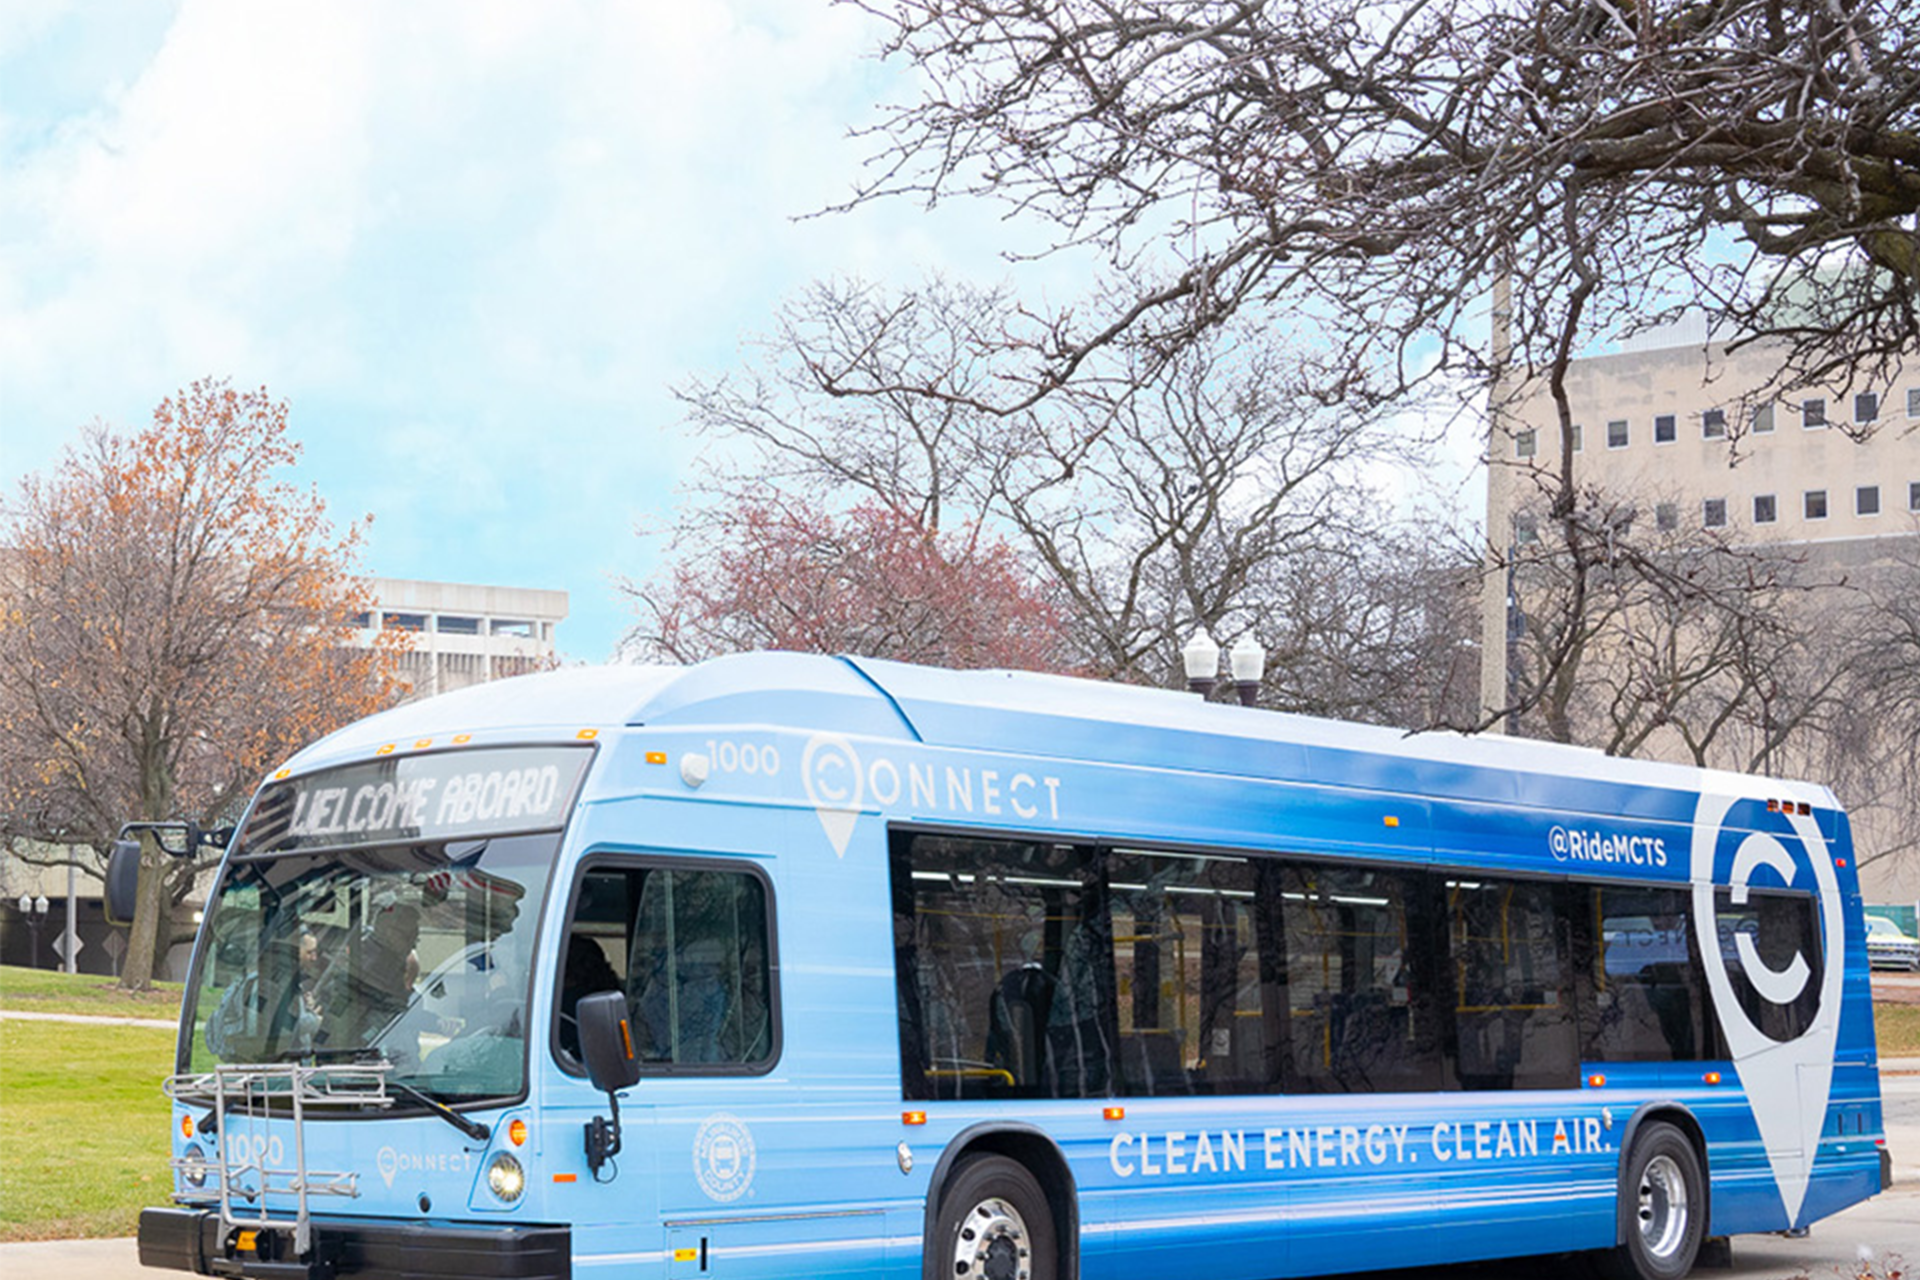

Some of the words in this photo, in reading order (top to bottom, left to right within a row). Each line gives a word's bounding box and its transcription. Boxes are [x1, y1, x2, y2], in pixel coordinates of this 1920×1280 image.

[706, 740, 780, 776] 1000
[804, 738, 1060, 820] CONNECT
[289, 780, 434, 836] WELCOME
[438, 766, 559, 825] ABOARD
[1549, 825, 1668, 867] @RideMCTS
[226, 1134, 284, 1166] 1000
[378, 1148, 471, 1173] CONNECT
[1109, 1130, 1246, 1177] CLEAN
[1264, 1124, 1417, 1168] ENERGY.
[1432, 1119, 1538, 1162] CLEAN
[1551, 1117, 1612, 1155] AIR.
